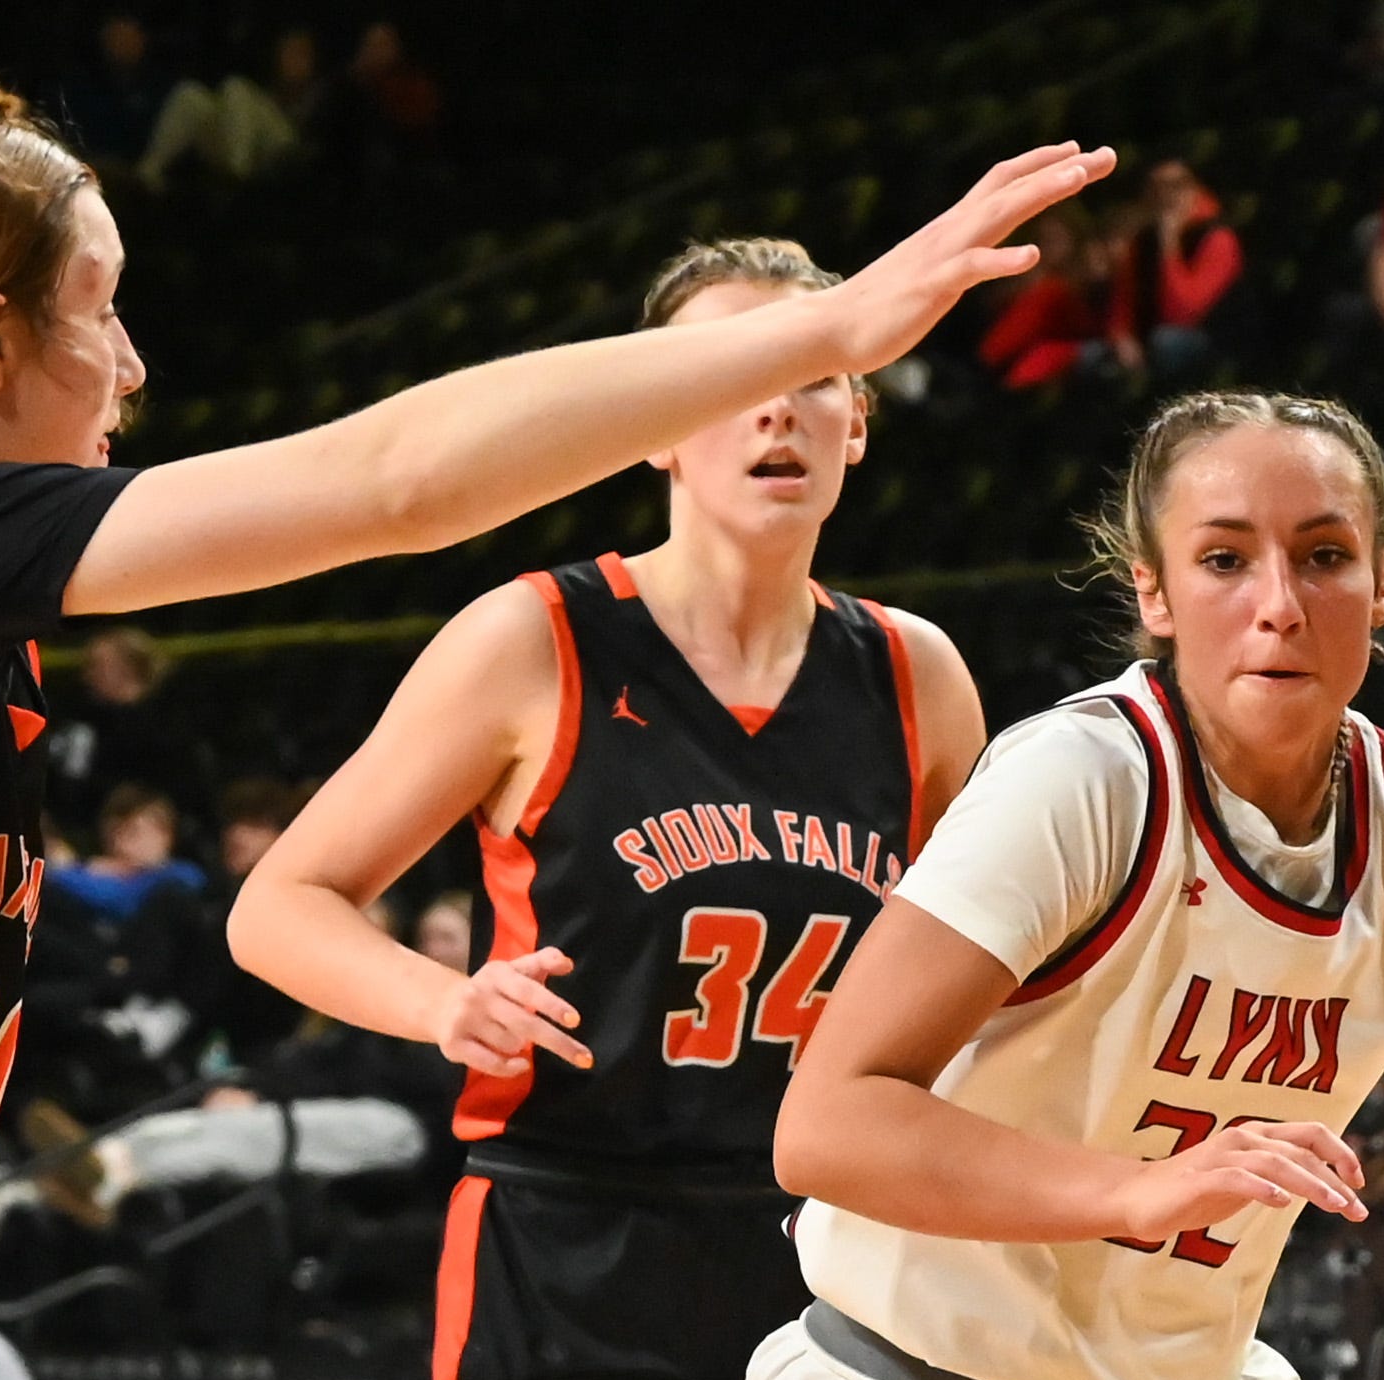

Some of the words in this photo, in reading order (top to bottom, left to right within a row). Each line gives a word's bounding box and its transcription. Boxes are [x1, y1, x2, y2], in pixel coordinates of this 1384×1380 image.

[613, 803, 771, 893] SIOUX
[662, 906, 851, 1072] 34
[1153, 974, 1350, 1094] LYNX
